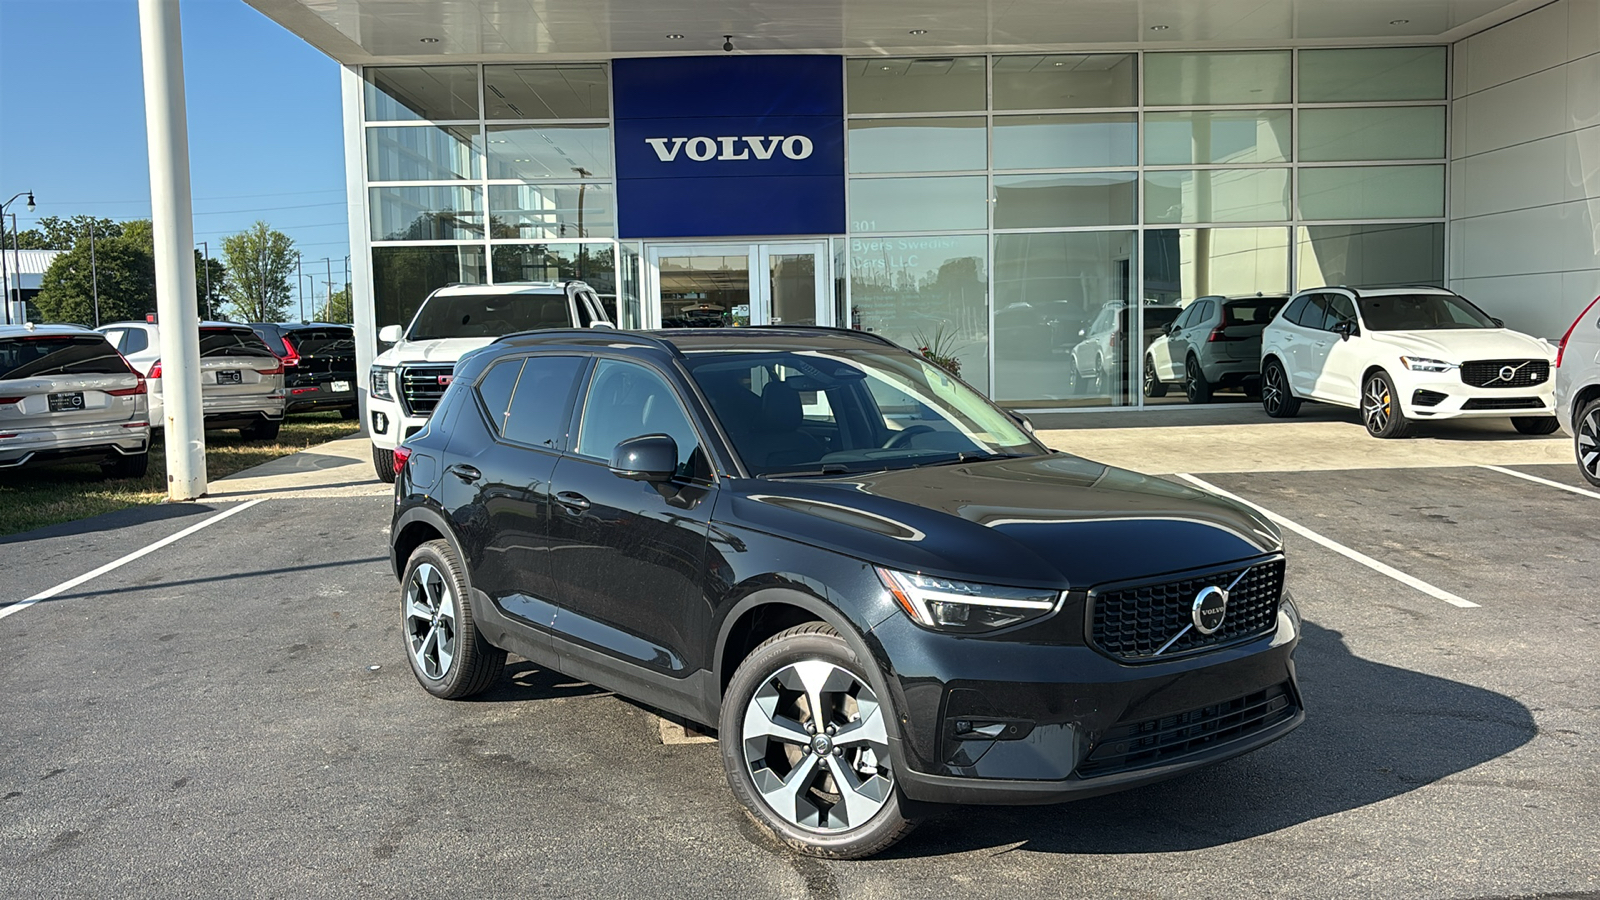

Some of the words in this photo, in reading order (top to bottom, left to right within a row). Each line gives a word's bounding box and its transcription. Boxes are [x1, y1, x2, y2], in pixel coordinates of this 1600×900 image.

[645, 135, 813, 161] VOLVO
[852, 220, 876, 232] 301
[852, 239, 893, 254] Byers
[852, 256, 885, 268] Cars
[890, 254, 919, 268] LLC
[1202, 606, 1224, 616] VOLVO
